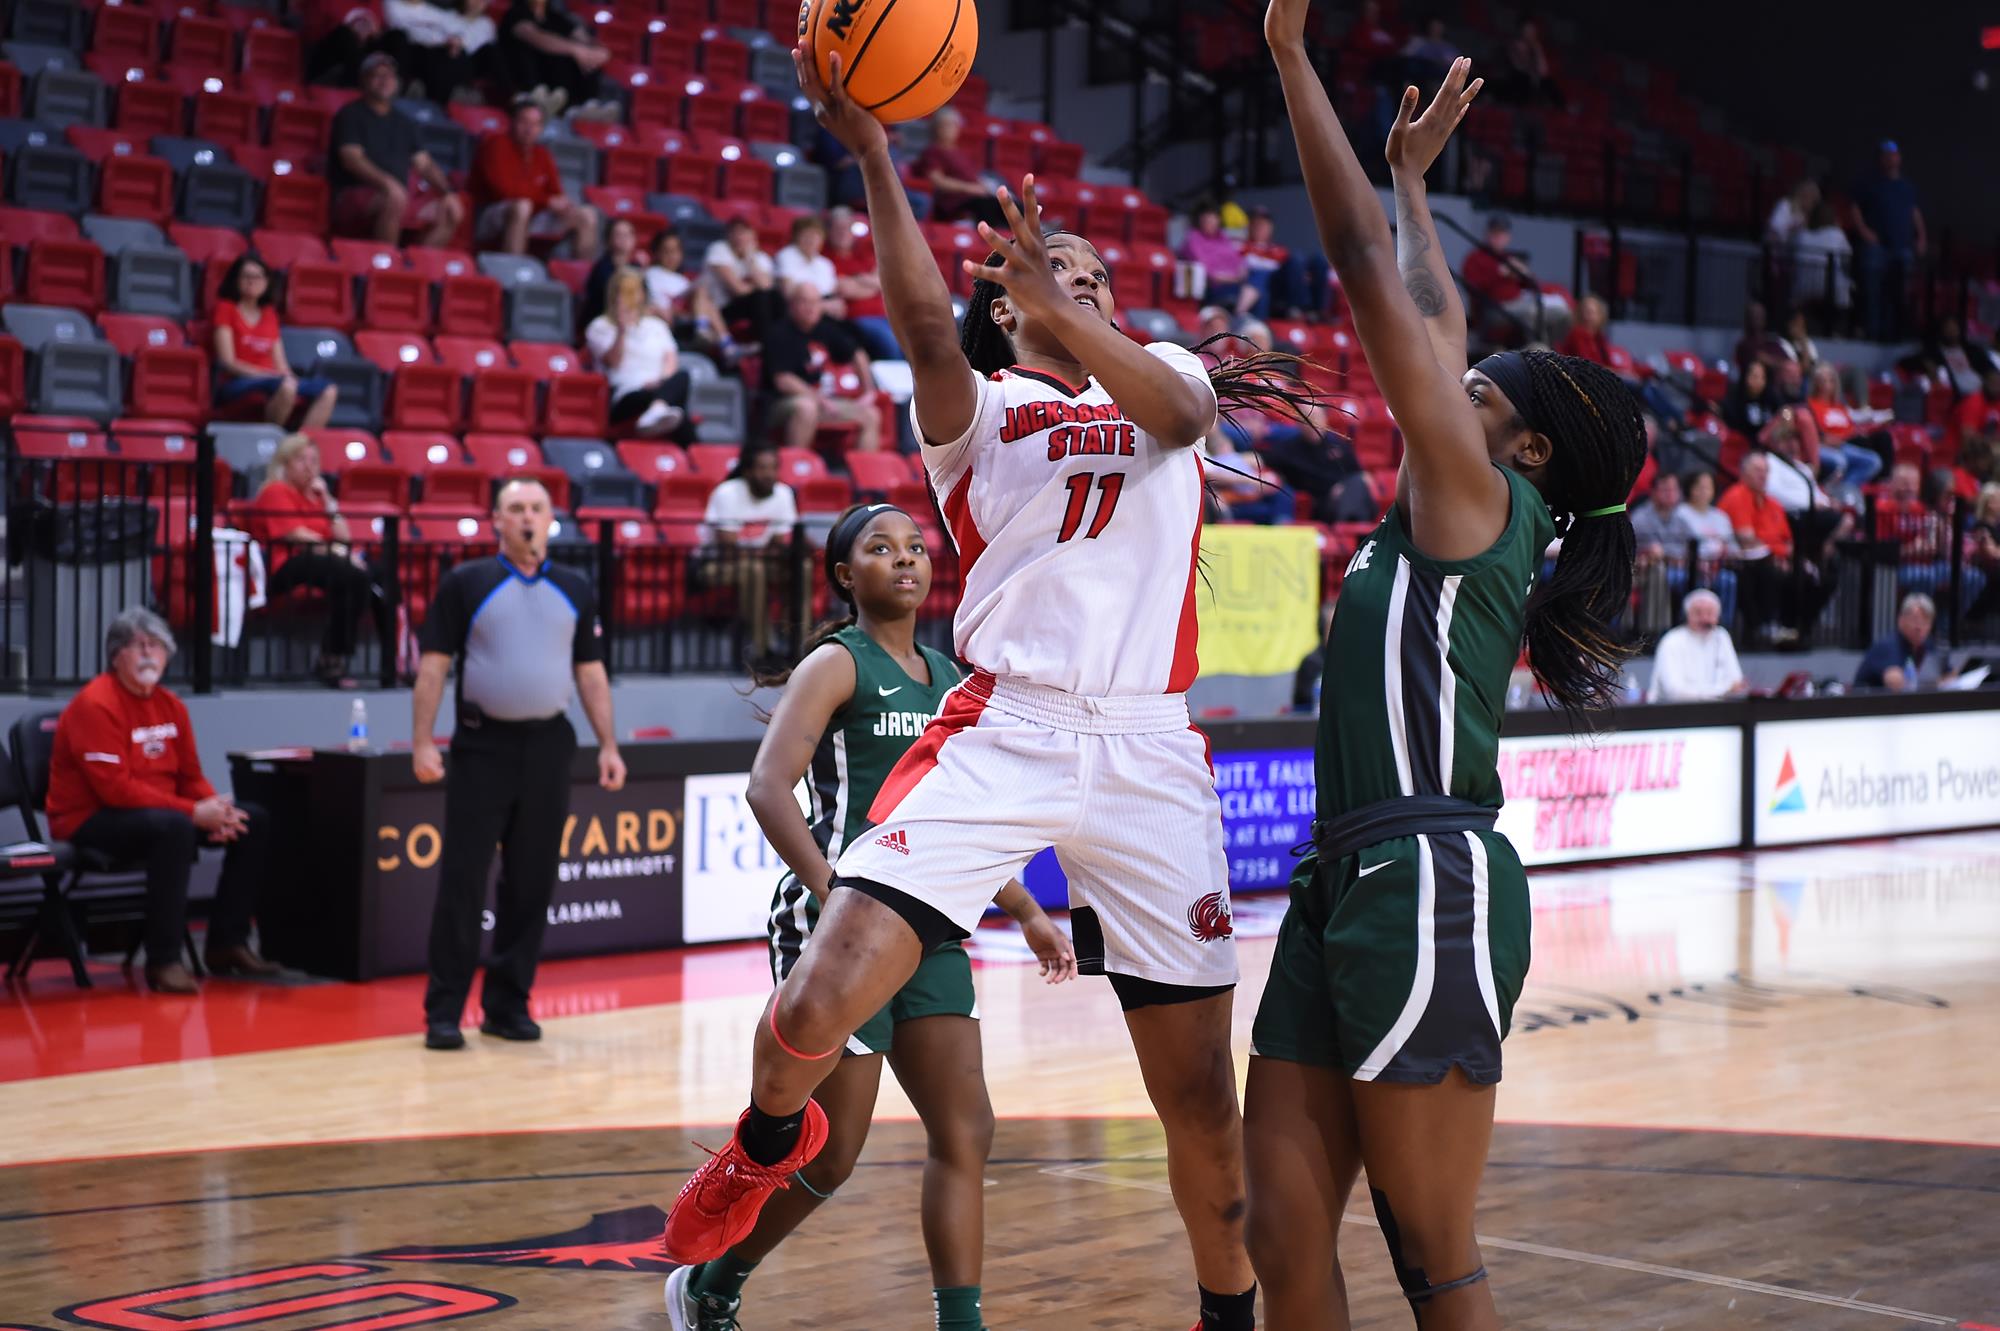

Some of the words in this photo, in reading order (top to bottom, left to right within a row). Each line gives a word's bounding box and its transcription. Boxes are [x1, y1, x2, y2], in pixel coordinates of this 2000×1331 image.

[1000, 401, 1131, 443] JACKSONV
[1048, 424, 1136, 462] STATE
[1057, 472, 1126, 543] 11
[1497, 740, 1685, 800] ACKSONVILLE
[1816, 763, 1930, 811] Alabama
[1936, 757, 2000, 802] Powe
[1534, 798, 1615, 852] STATE
[558, 862, 582, 882] BY
[585, 854, 676, 879] MARRIOTT
[875, 839, 911, 856] adidas
[546, 899, 622, 925] LABAMA
